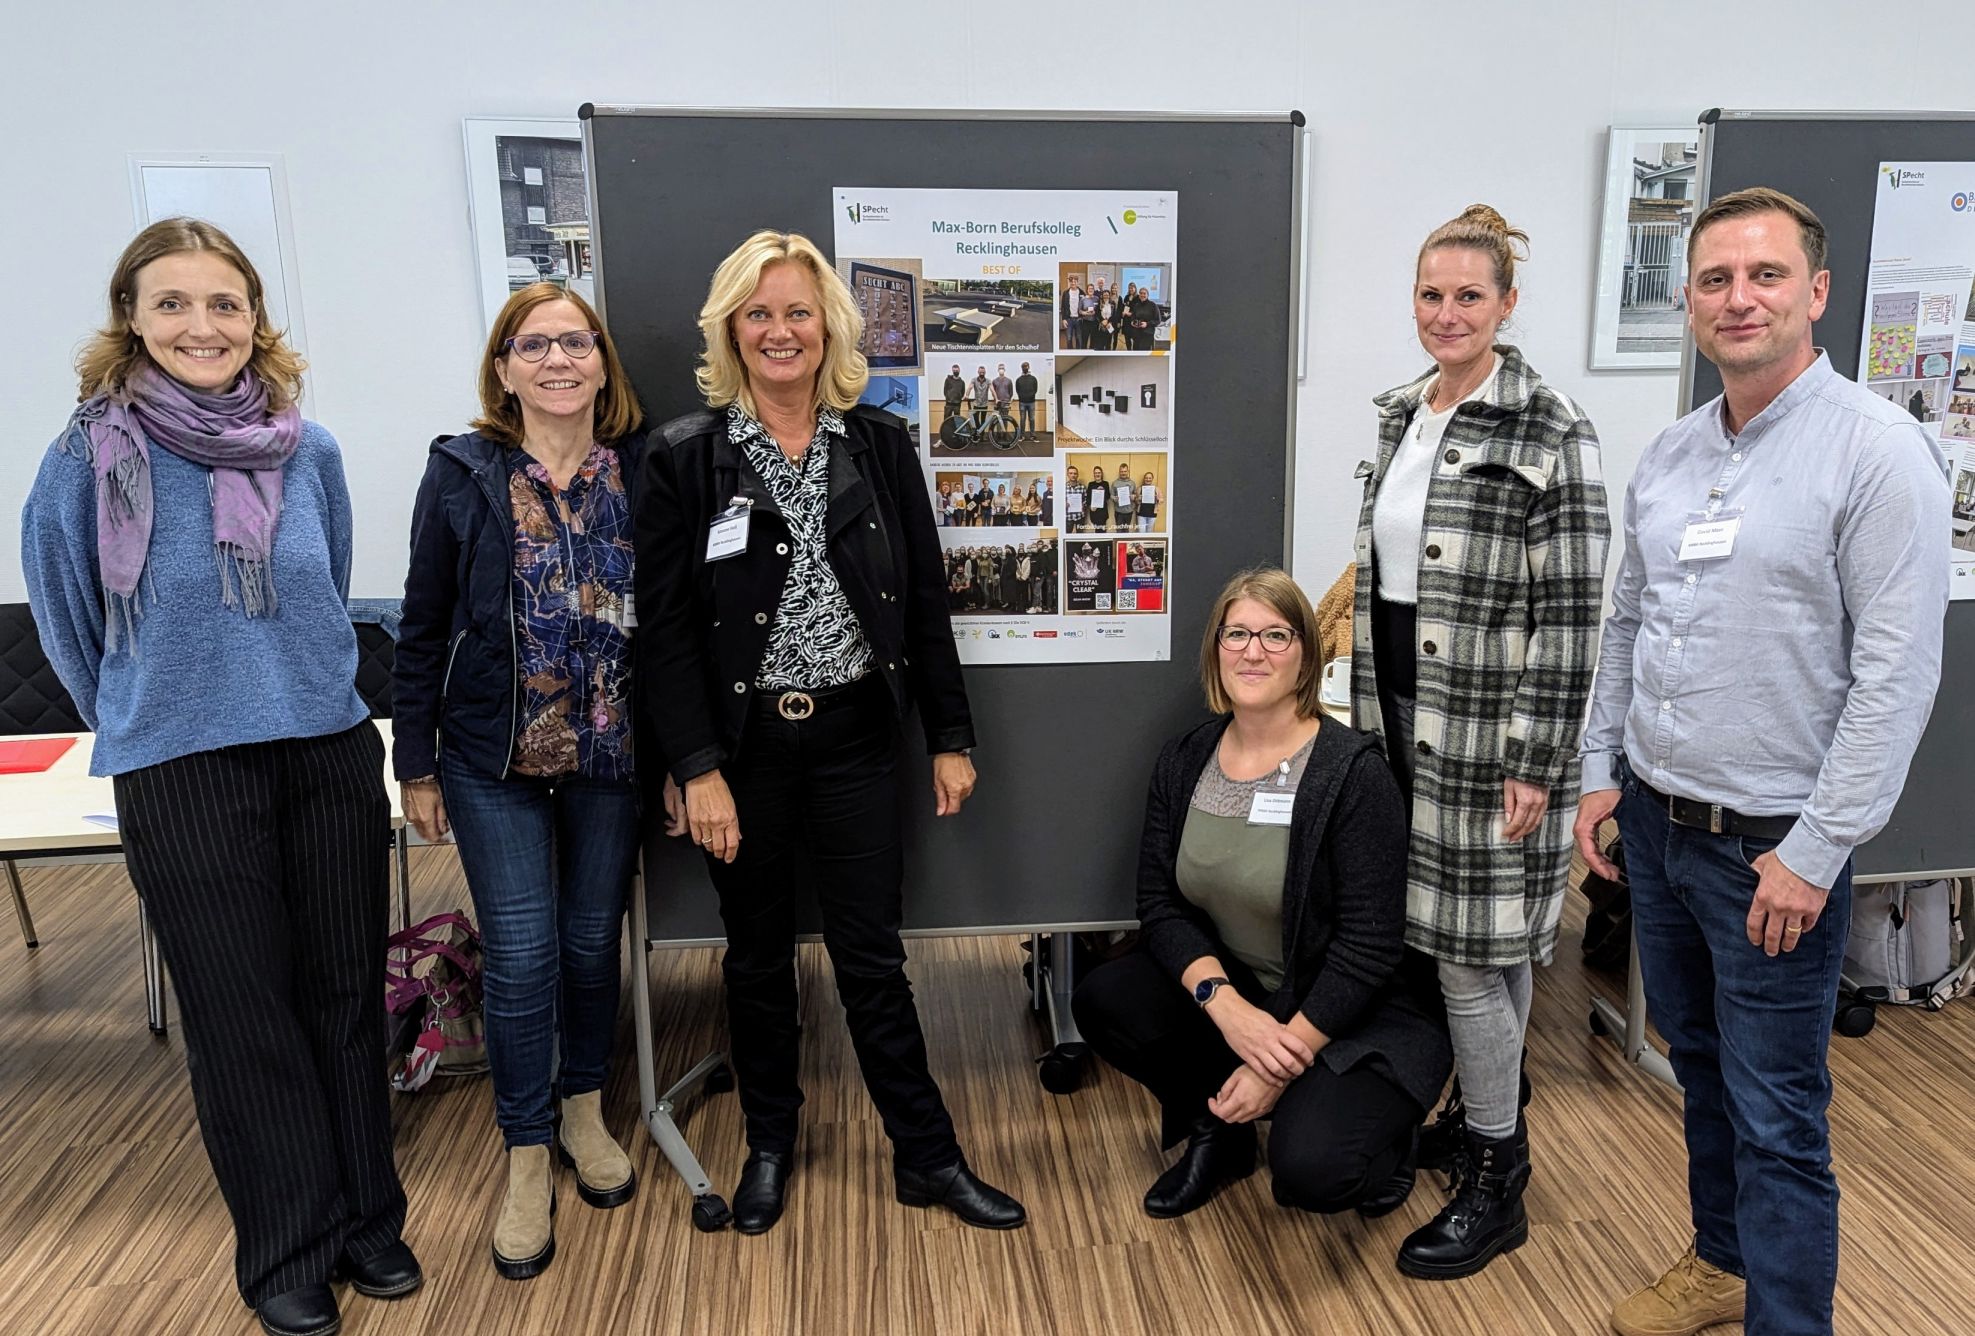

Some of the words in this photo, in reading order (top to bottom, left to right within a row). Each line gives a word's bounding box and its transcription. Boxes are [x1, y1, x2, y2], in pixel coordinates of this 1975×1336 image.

[1902, 171, 1925, 179] SPecht
[862, 205, 889, 214] SPecht
[932, 220, 997, 234] Max-Born
[1001, 221, 1081, 238] Berufskolleg
[956, 242, 1058, 257] Recklinghausen
[982, 265, 1006, 275] BEST
[1008, 265, 1022, 275] OF
[862, 276, 888, 289] SUCHT
[890, 281, 906, 292] ABC
[1016, 343, 1040, 351] Schulhof
